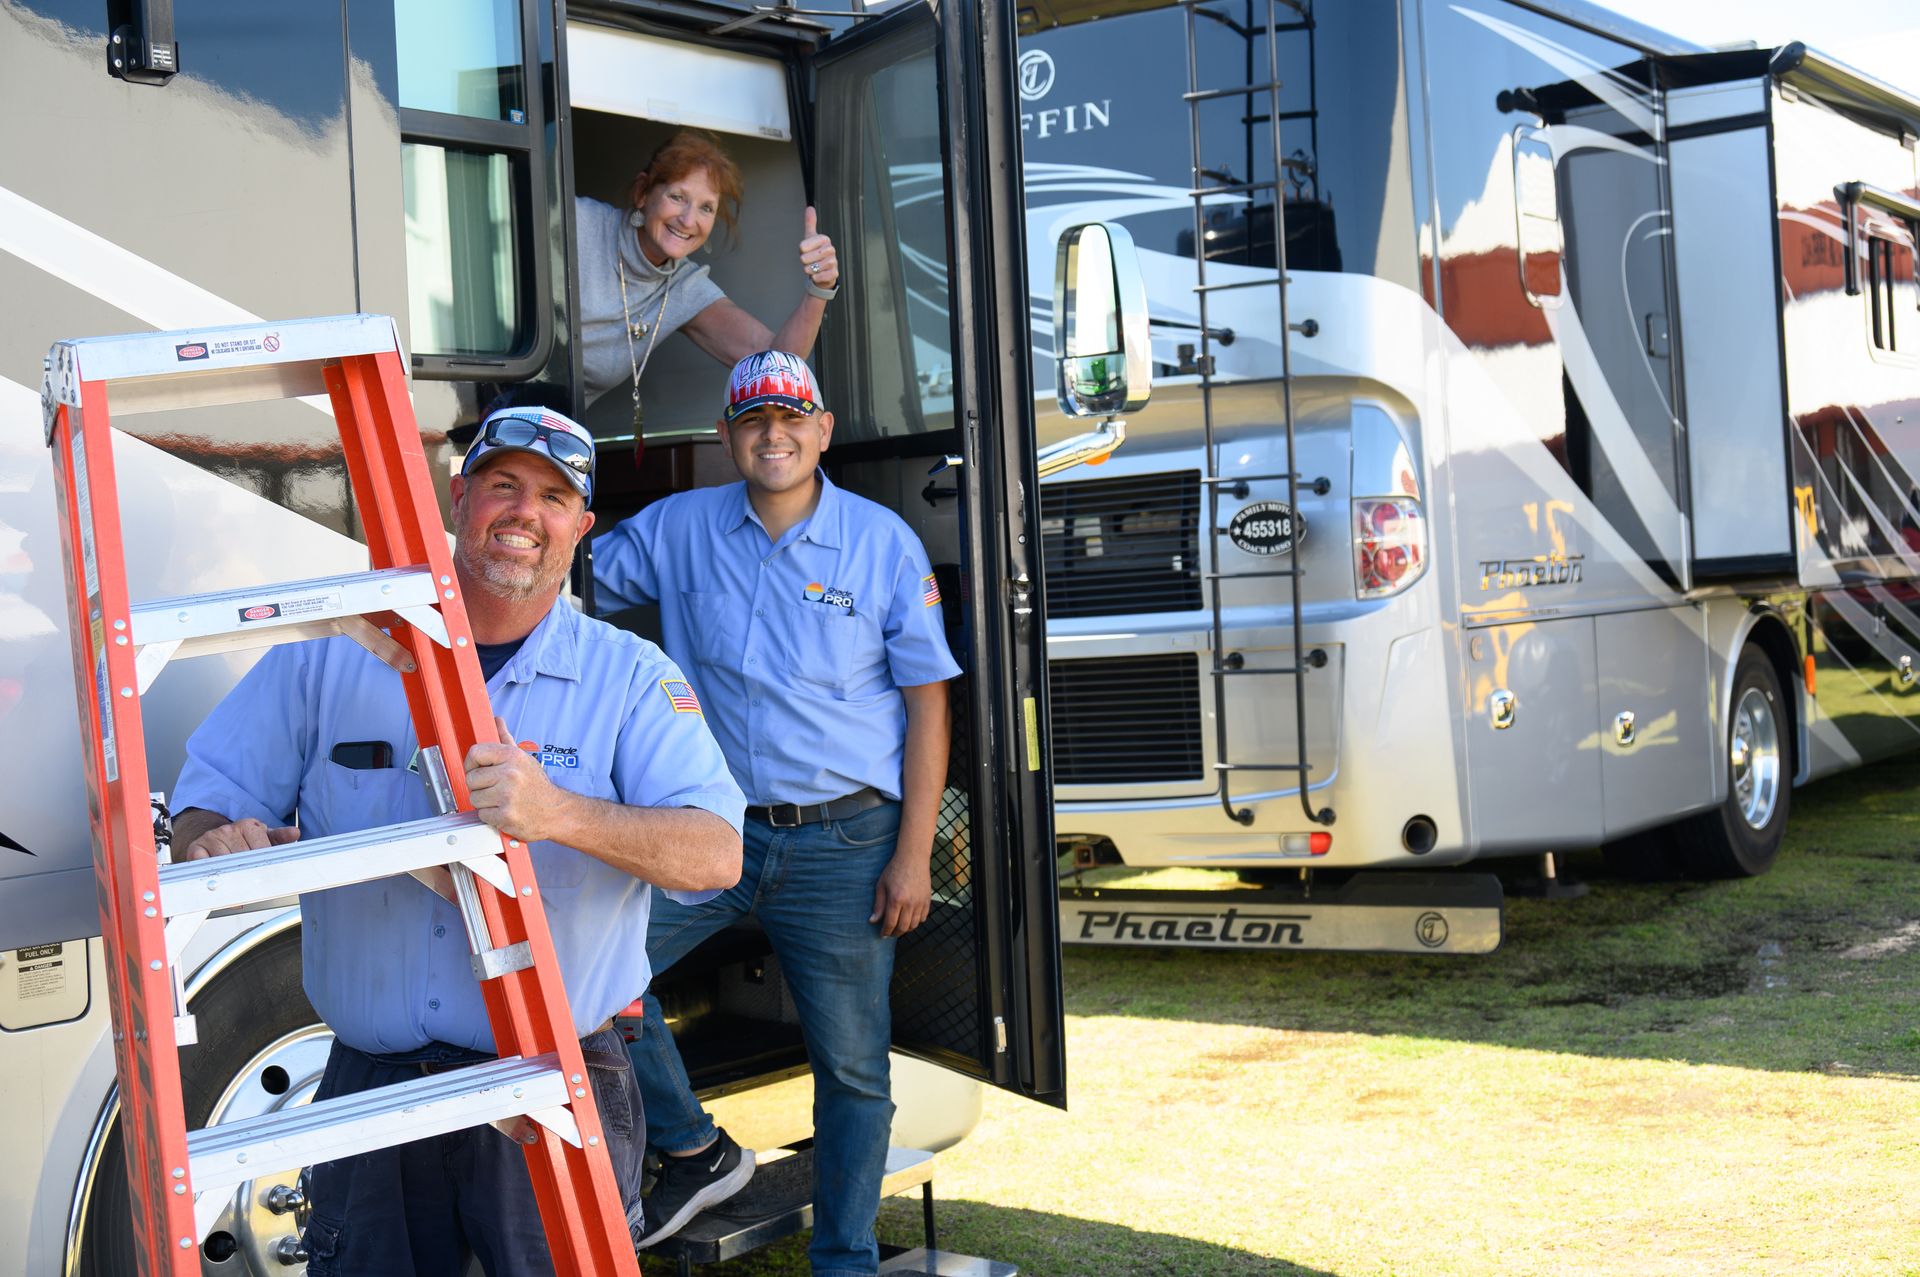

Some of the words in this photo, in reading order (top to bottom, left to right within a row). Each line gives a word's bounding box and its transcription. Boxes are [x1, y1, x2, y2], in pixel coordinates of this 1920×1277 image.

[1235, 503, 1267, 524] FAMILY
[1267, 503, 1292, 516] MOTO
[1243, 518, 1292, 539] 455318
[1237, 539, 1269, 554] COACH
[1478, 552, 1585, 591] Phaeton
[826, 586, 853, 597] Shade
[824, 594, 852, 608] PRO
[542, 744, 578, 755] Shade
[541, 753, 577, 768] PRO
[1077, 908, 1312, 944] Phaeton
[24, 951, 39, 959] FUEL
[39, 947, 55, 956] ONLY
